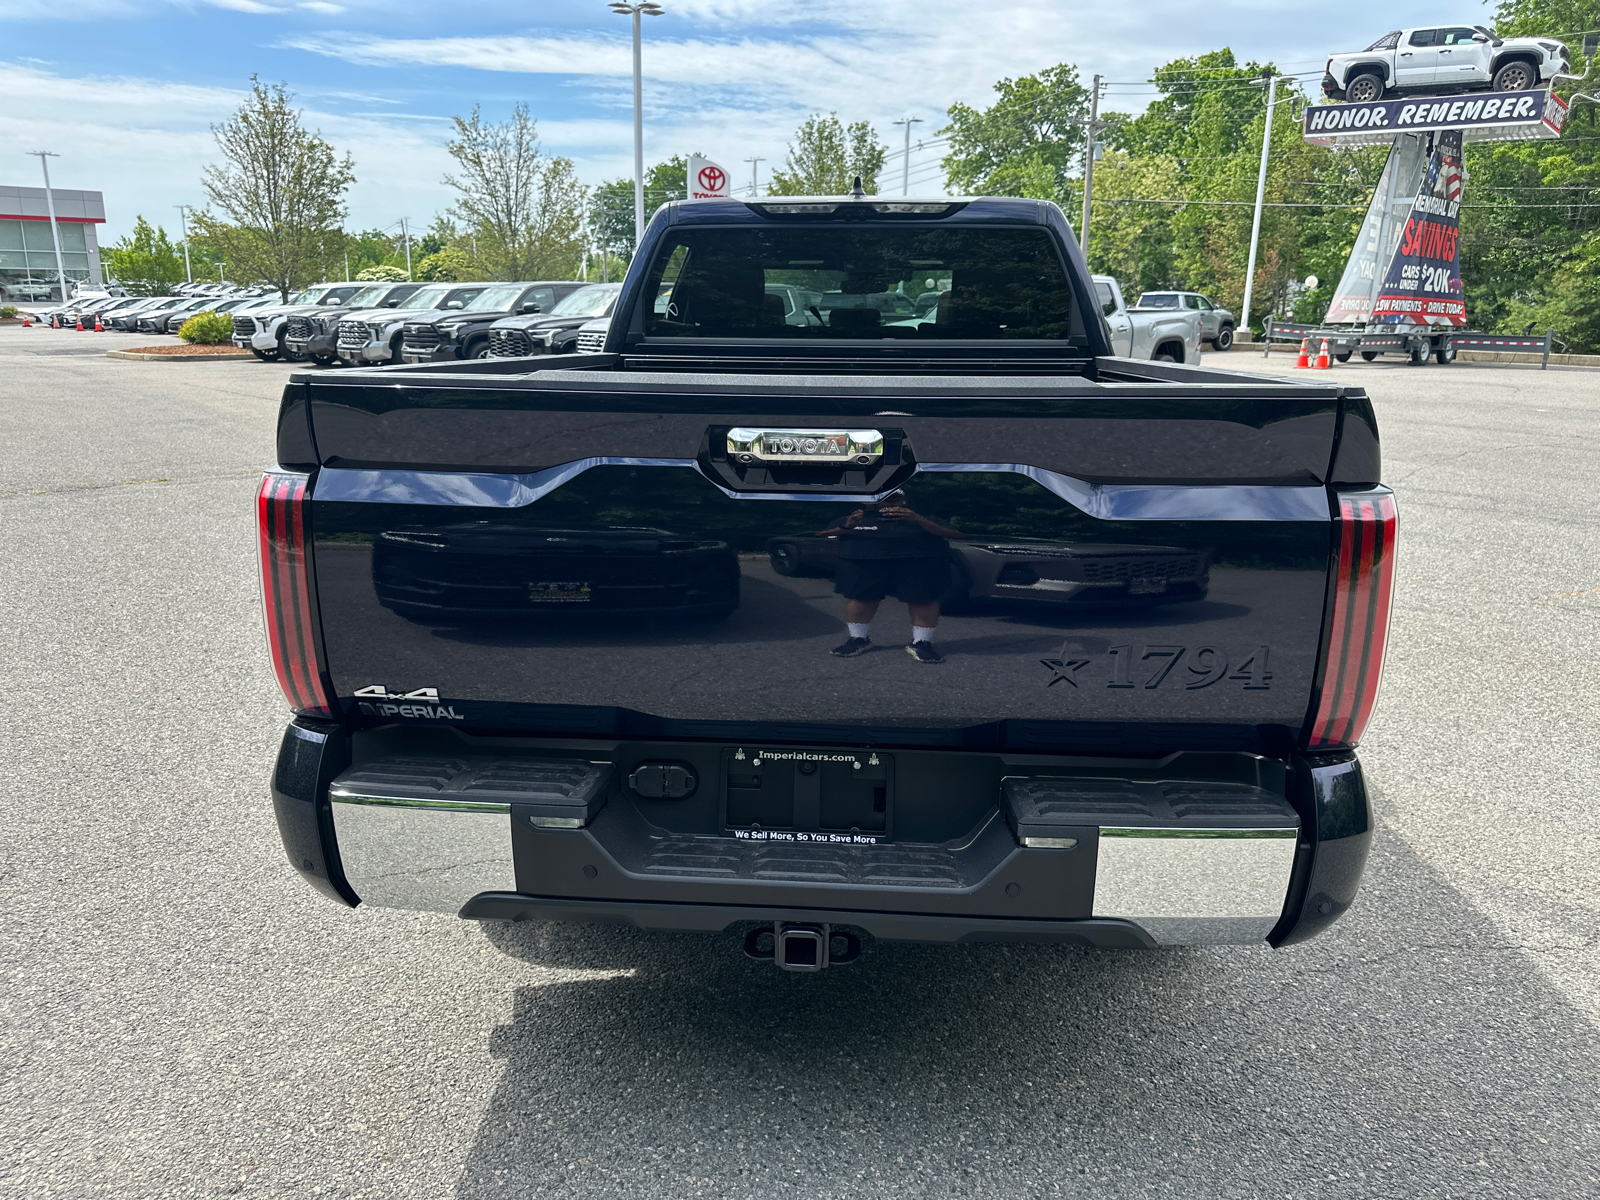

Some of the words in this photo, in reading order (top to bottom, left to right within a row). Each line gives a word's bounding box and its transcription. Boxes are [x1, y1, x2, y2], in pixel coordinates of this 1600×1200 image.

[1310, 106, 1389, 131] HONOR.
[1398, 96, 1537, 125] REMEMBER.
[1413, 194, 1447, 216] MEMORIAL
[1447, 200, 1460, 219] DAY
[1401, 218, 1459, 263] SAVINGS
[1399, 279, 1419, 291] UNDER
[1401, 264, 1421, 279] CARS
[1421, 263, 1451, 294] $20K
[1375, 299, 1391, 312] LOW
[1390, 299, 1422, 313] PAYMENTS
[1427, 301, 1445, 314] DRIVE
[768, 436, 840, 454] TOYOTA
[1106, 644, 1273, 690] 1794
[353, 684, 439, 701] 4x4
[358, 701, 465, 719] IMPERIAL
[758, 750, 856, 762] Imperialcars.com
[735, 830, 749, 839] We
[751, 831, 768, 839] Sell
[770, 832, 794, 841] More,
[797, 833, 808, 841] So
[810, 833, 828, 842] You
[830, 834, 851, 843] Save
[853, 835, 876, 844] More
